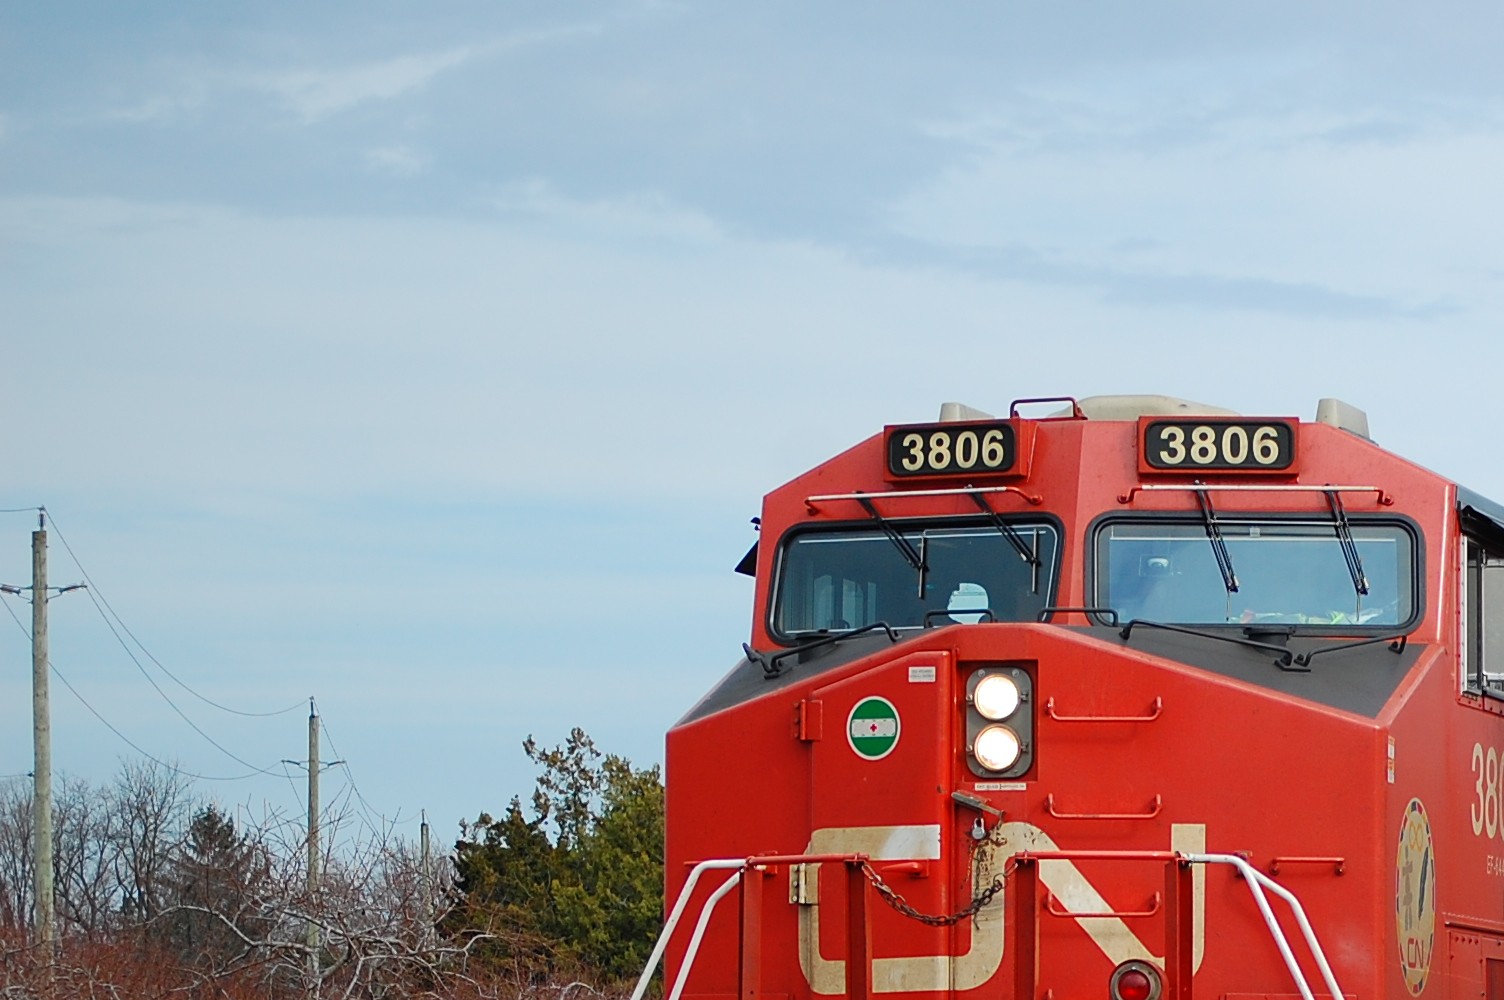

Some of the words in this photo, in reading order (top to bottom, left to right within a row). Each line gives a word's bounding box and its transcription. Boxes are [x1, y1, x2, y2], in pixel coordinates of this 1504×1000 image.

[901, 428, 1005, 472] 3806
[1159, 425, 1280, 465] 3806
[799, 822, 1206, 995] CN
[1407, 937, 1424, 969] CN
